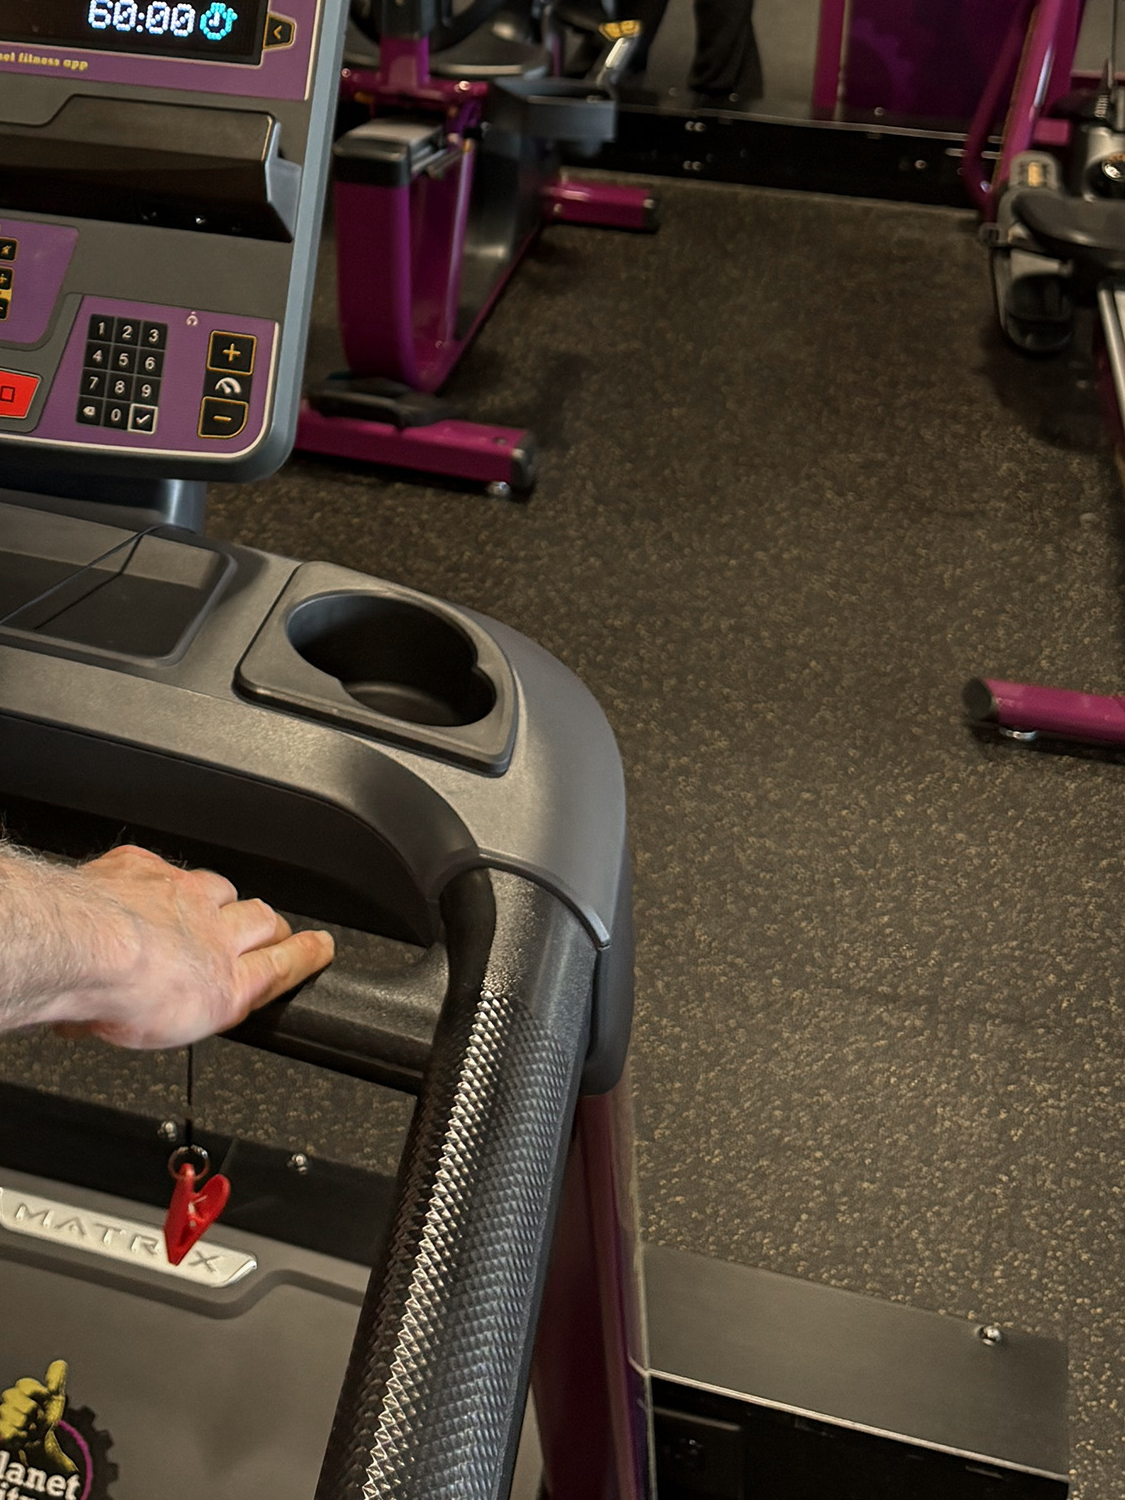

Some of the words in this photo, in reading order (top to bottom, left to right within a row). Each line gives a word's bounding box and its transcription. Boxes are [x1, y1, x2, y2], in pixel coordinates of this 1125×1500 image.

[18, 53, 60, 67] fitness
[63, 59, 89, 71] app
[97, 321, 106, 336] 1
[122, 325, 133, 340] 2
[148, 328, 159, 343] 3
[92, 349, 102, 364] 4
[118, 352, 129, 367] 5
[144, 356, 156, 371] 6
[88, 376, 99, 390] 7
[114, 380, 125, 395] 8
[141, 383, 152, 398] 9
[111, 408, 122, 422] 0
[15, 1203, 219, 1274] MATRX
